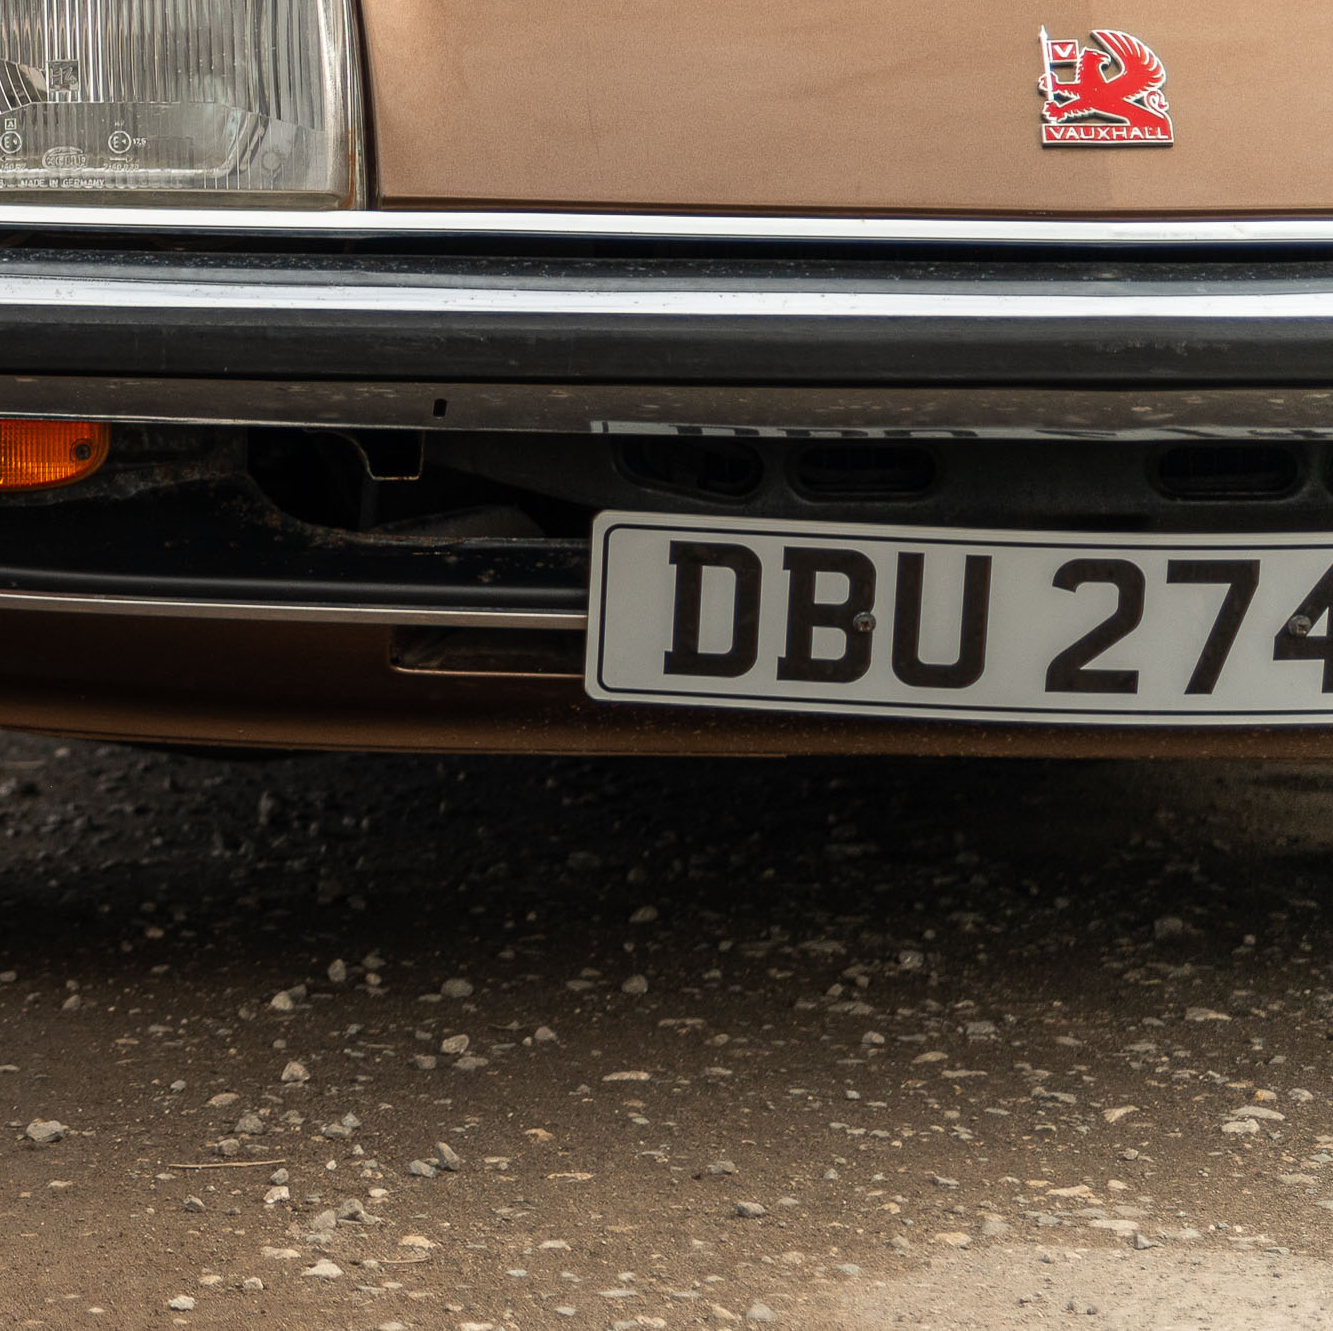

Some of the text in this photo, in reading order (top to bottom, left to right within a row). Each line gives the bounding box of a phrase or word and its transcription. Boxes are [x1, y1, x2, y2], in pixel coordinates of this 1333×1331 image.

[1053, 43, 1074, 58] V
[1048, 126, 1169, 140] VAUXHALL
[20, 178, 46, 187] MADE
[49, 178, 59, 188] IN
[62, 178, 106, 188] GERMANY
[663, 540, 1333, 695] DBU 274
